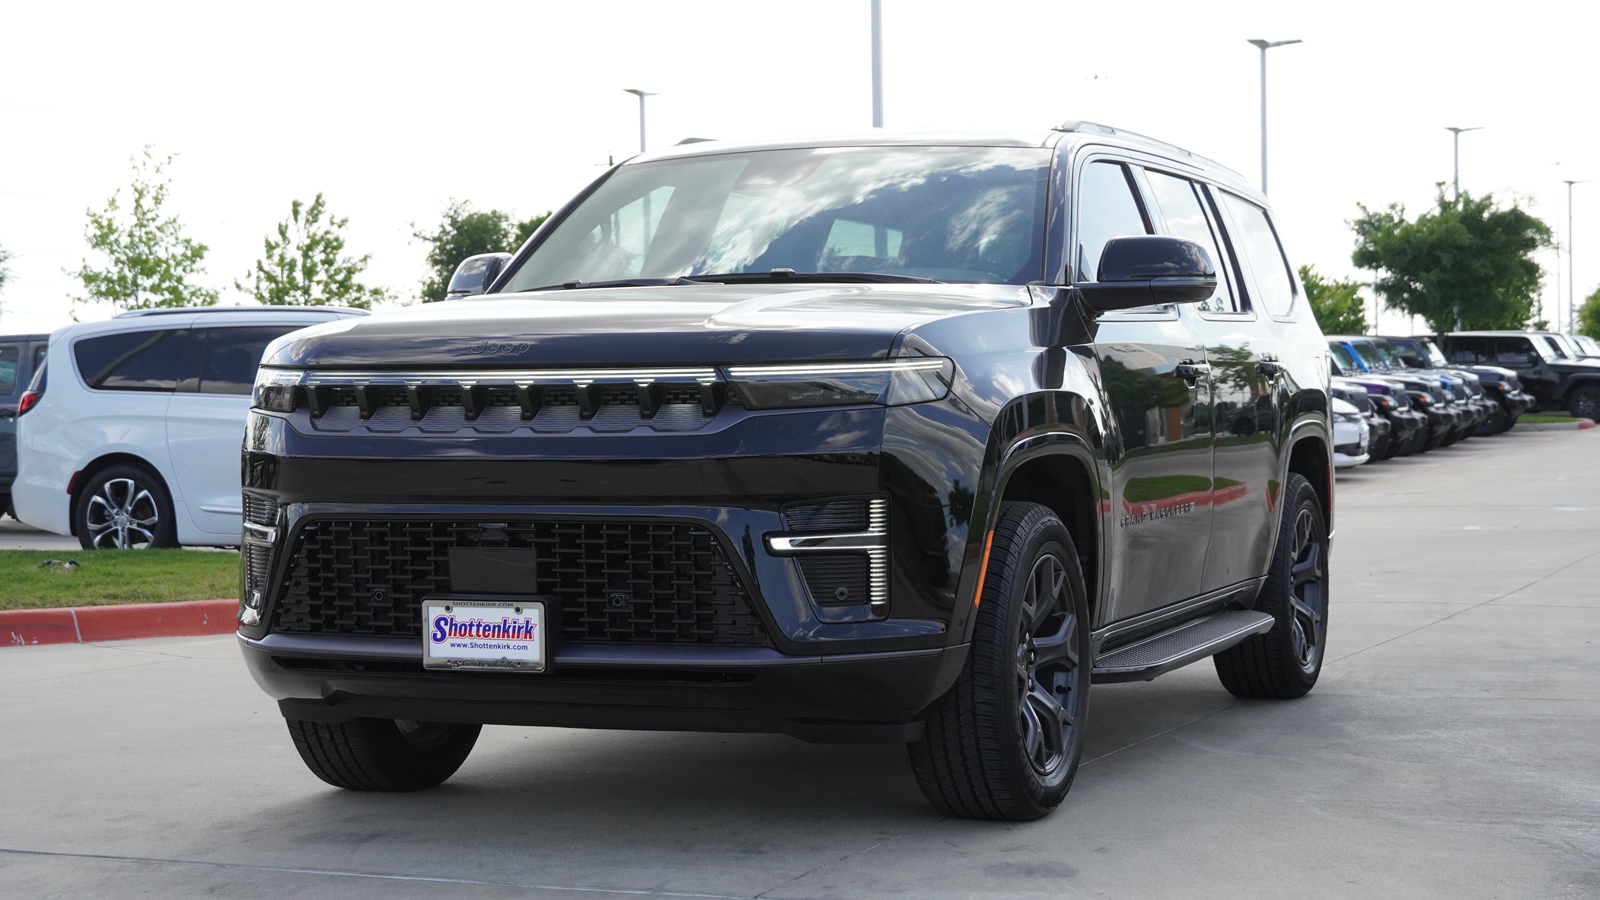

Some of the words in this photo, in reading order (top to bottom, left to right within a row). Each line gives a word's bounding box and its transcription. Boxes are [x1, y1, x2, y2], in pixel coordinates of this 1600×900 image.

[470, 341, 530, 356] Jeep
[1120, 512, 1146, 527] GRAND
[1149, 502, 1195, 520] WAGONEER
[432, 615, 536, 643] Shottenkirk
[450, 641, 528, 651] www.Shottenkirk.com
